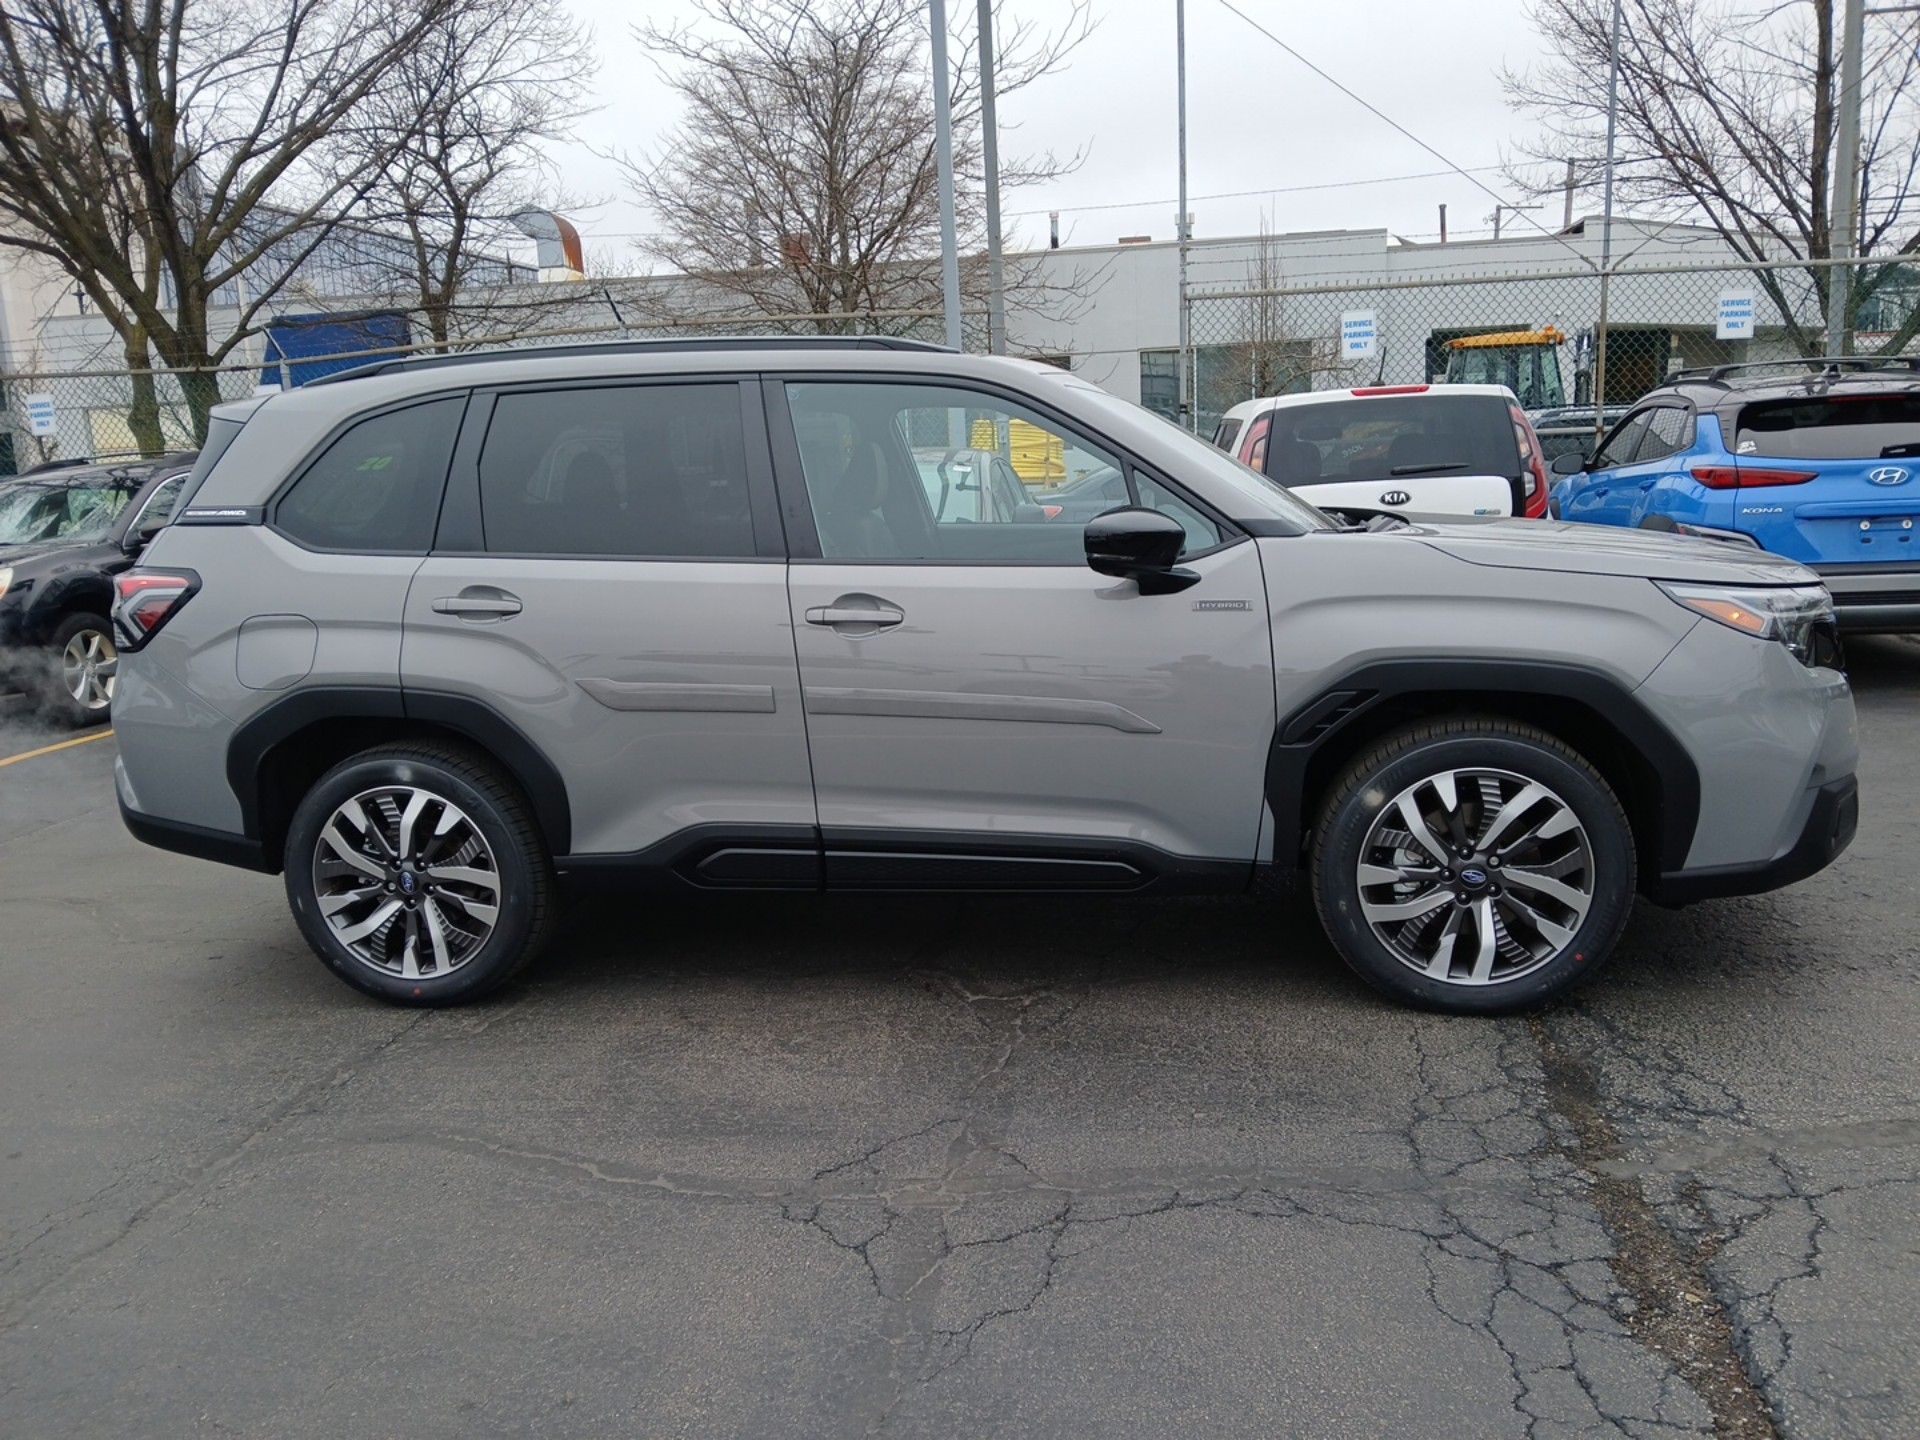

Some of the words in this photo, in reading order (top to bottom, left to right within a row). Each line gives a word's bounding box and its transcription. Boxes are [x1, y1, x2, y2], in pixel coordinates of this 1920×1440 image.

[1721, 299, 1751, 307] SERVICE
[1720, 310, 1752, 318] PARKING
[1344, 320, 1372, 328] SERVICE
[1726, 321, 1745, 329] ONLY
[1343, 331, 1374, 339] PARKING
[1385, 493, 1406, 503] KIA
